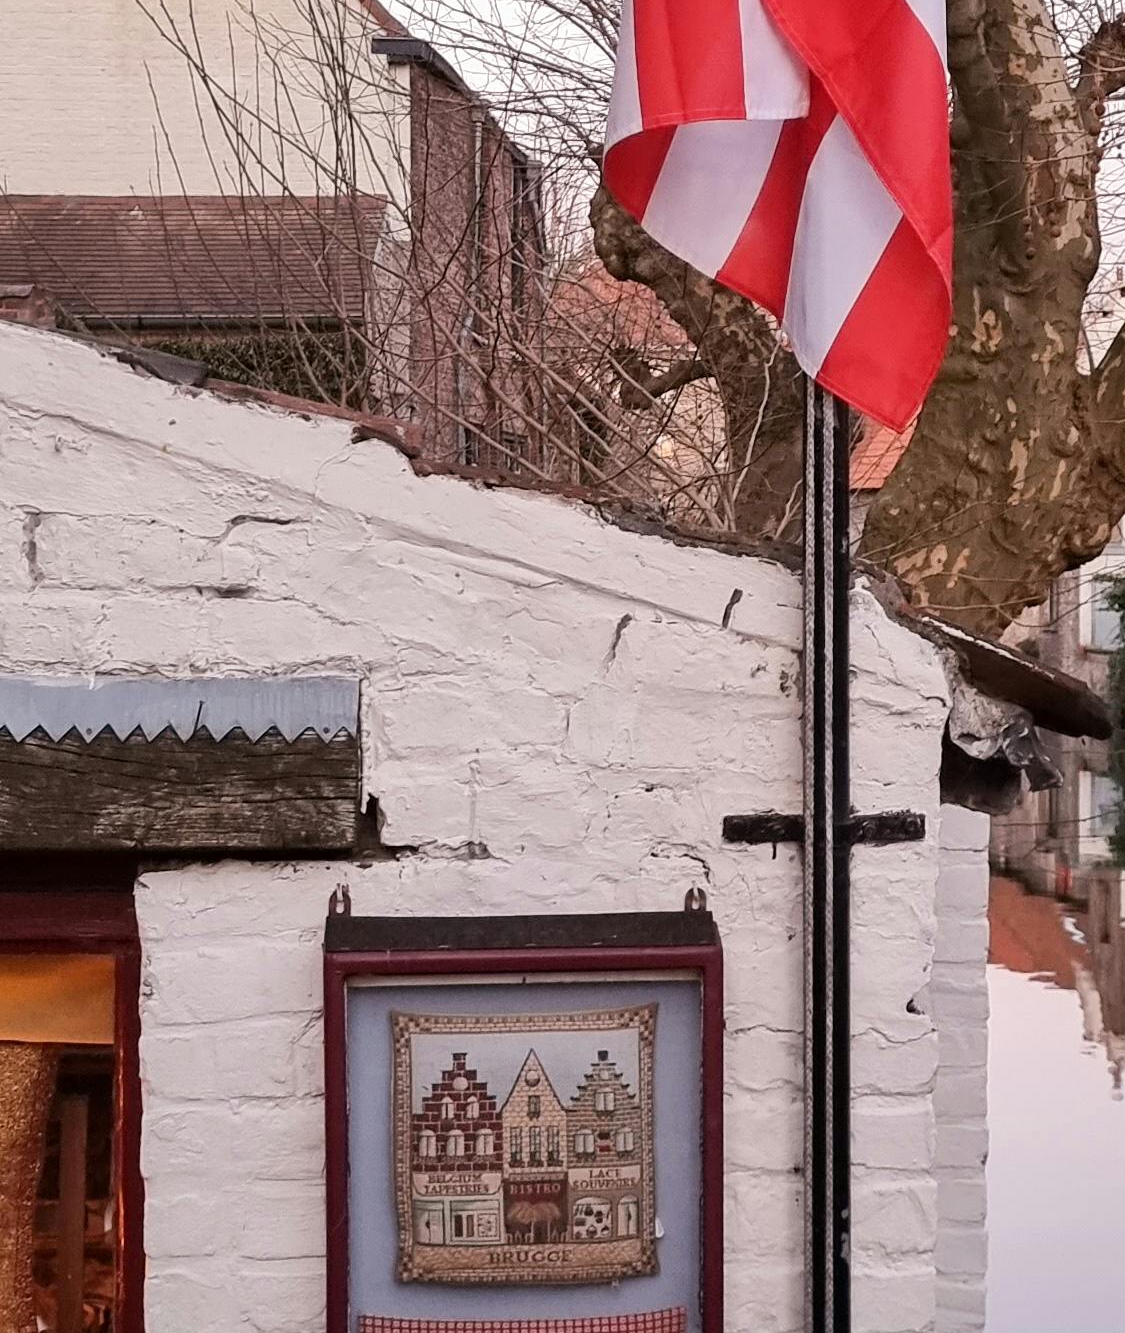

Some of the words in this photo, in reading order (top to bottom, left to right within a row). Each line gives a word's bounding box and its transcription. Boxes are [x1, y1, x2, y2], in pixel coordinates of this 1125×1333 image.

[588, 1168, 621, 1179] LACE
[509, 1182, 562, 1195] BISTRO
[573, 1177, 636, 1190] SOUVENIRS
[489, 1249, 573, 1264] BRUGGE
